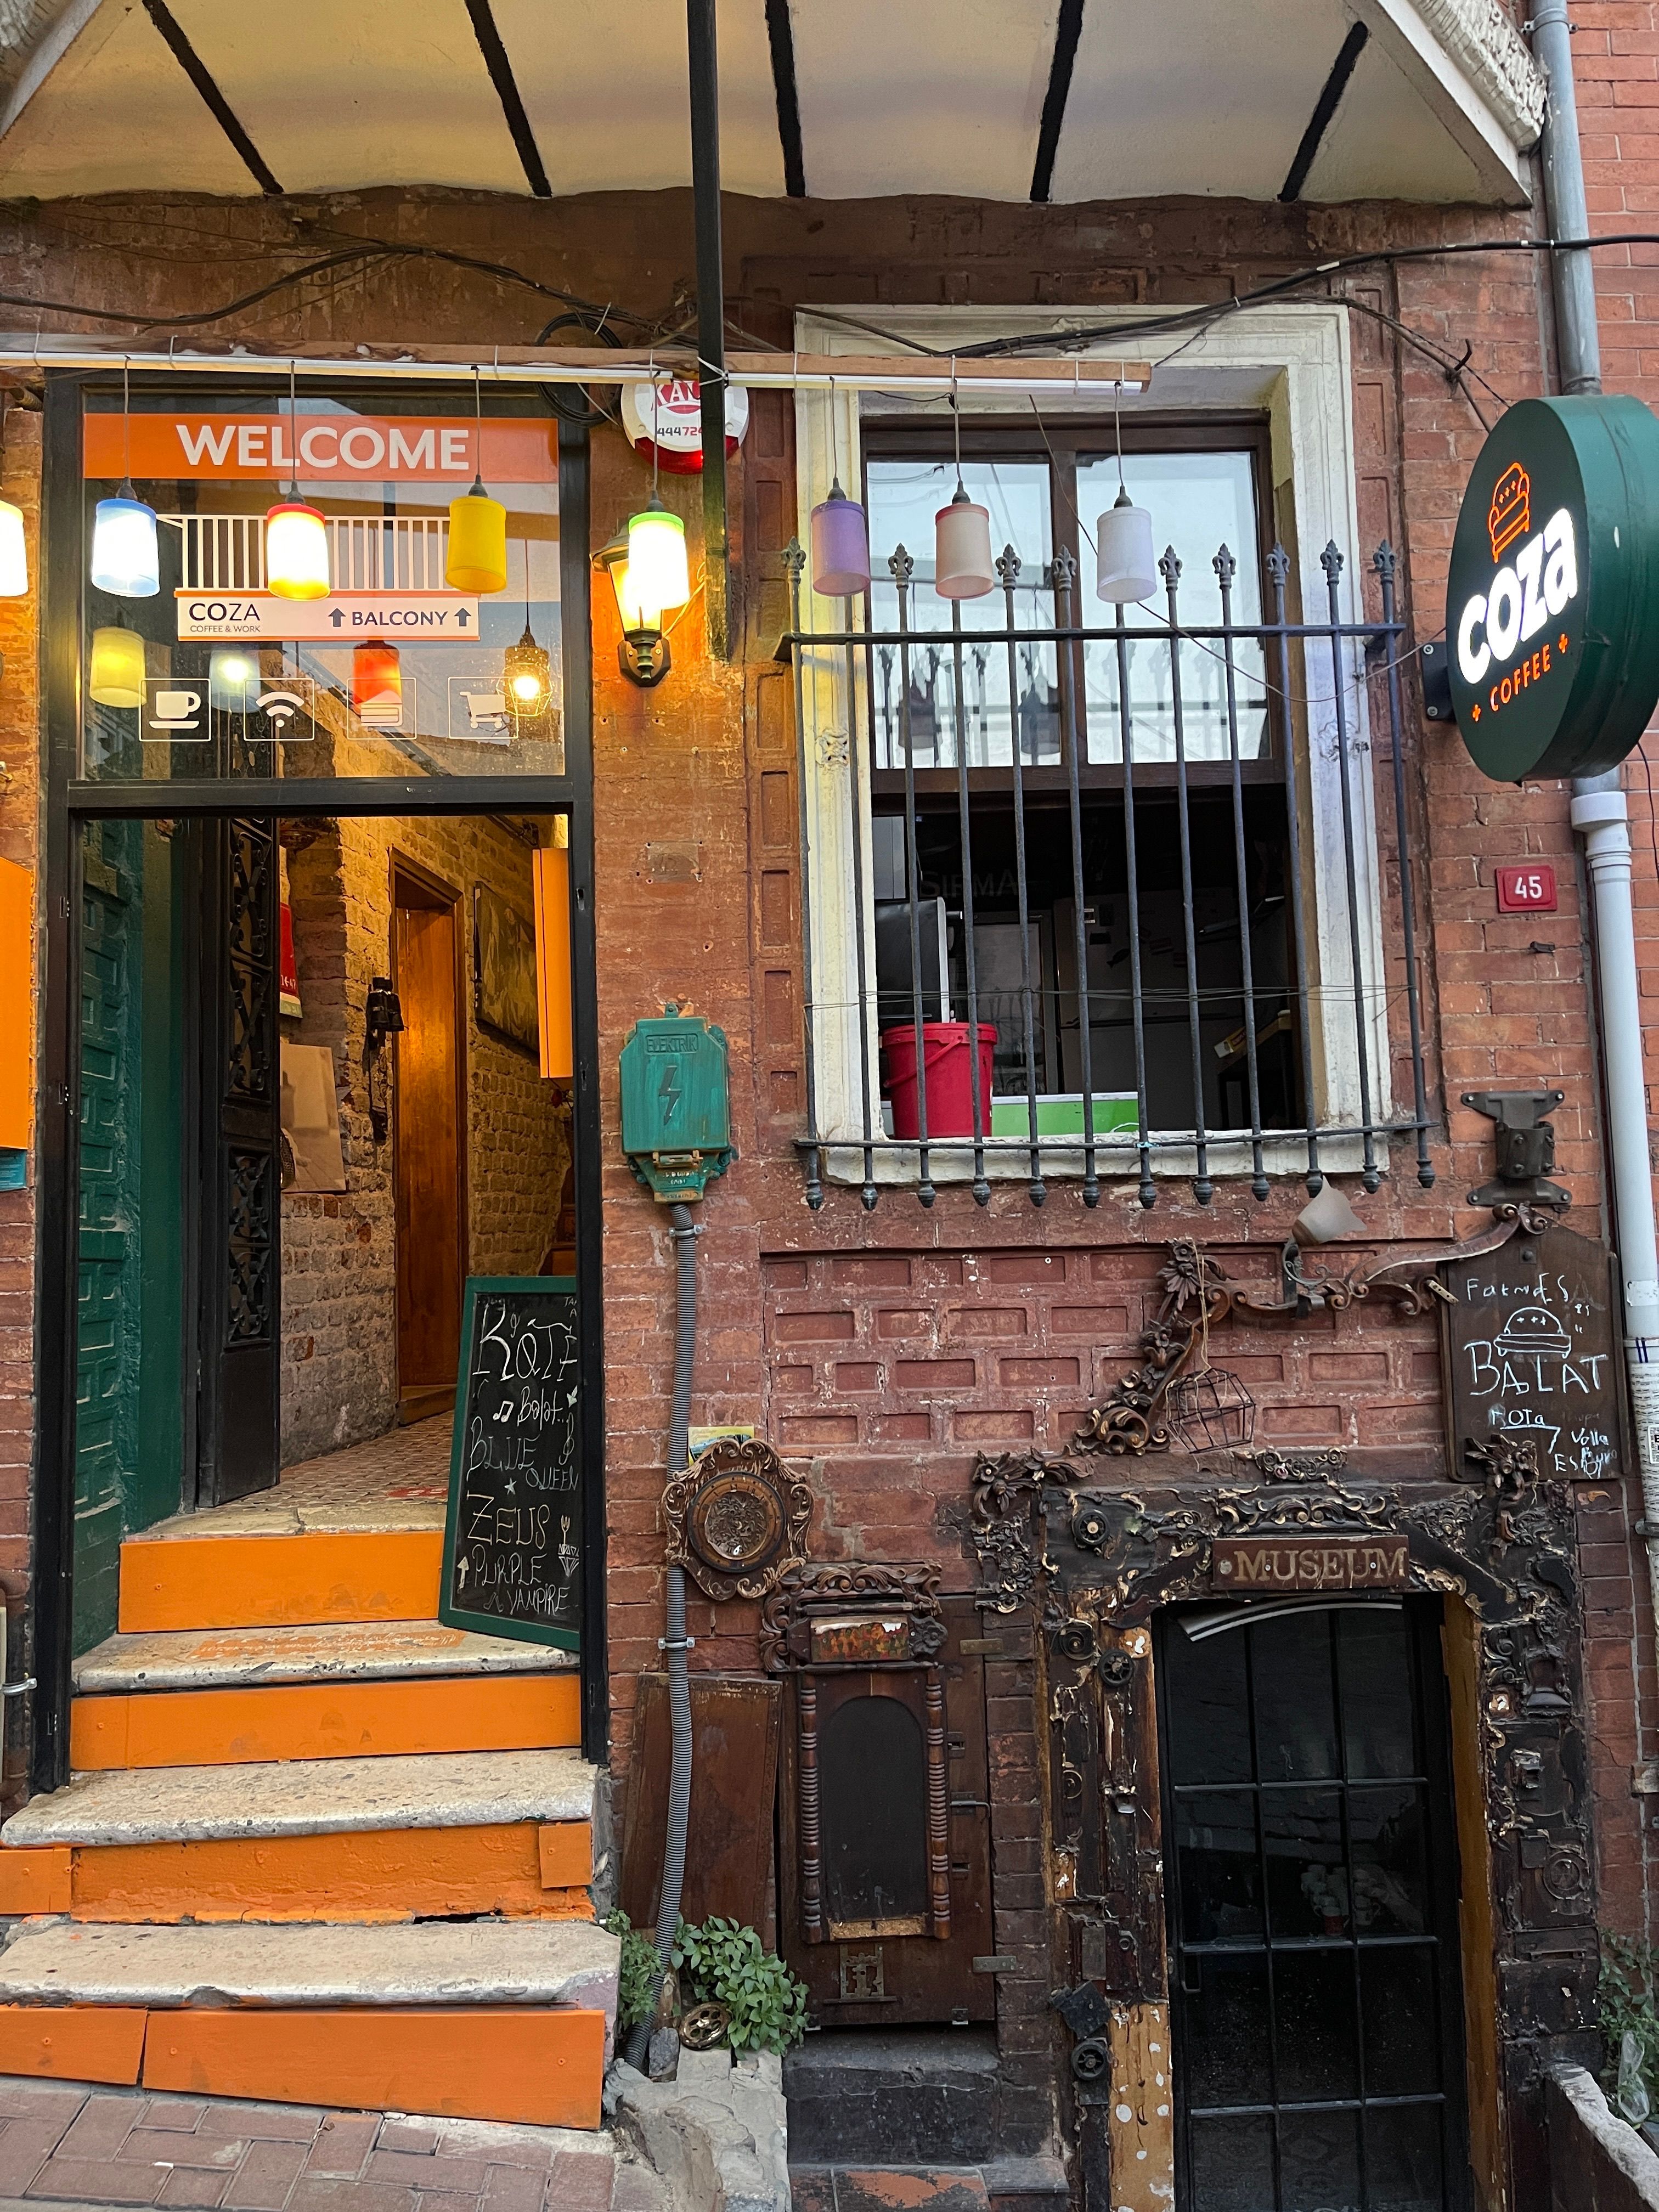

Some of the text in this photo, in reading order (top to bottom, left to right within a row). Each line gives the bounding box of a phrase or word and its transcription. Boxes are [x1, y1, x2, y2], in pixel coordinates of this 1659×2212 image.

[176, 424, 470, 470] WELCOME
[189, 603, 261, 621] COZA
[352, 610, 448, 627] BALCONY
[1489, 644, 1551, 712] COFFEE
[1514, 876, 1543, 899] 45
[1464, 1341, 1609, 1397] BALAT
[466, 1416, 540, 1481] BLUE
[525, 1465, 579, 1491] QUEEN
[466, 1490, 550, 1550] ZEUS
[472, 1544, 548, 1587] PURPLE
[1233, 1547, 1407, 1583] MUSEUM
